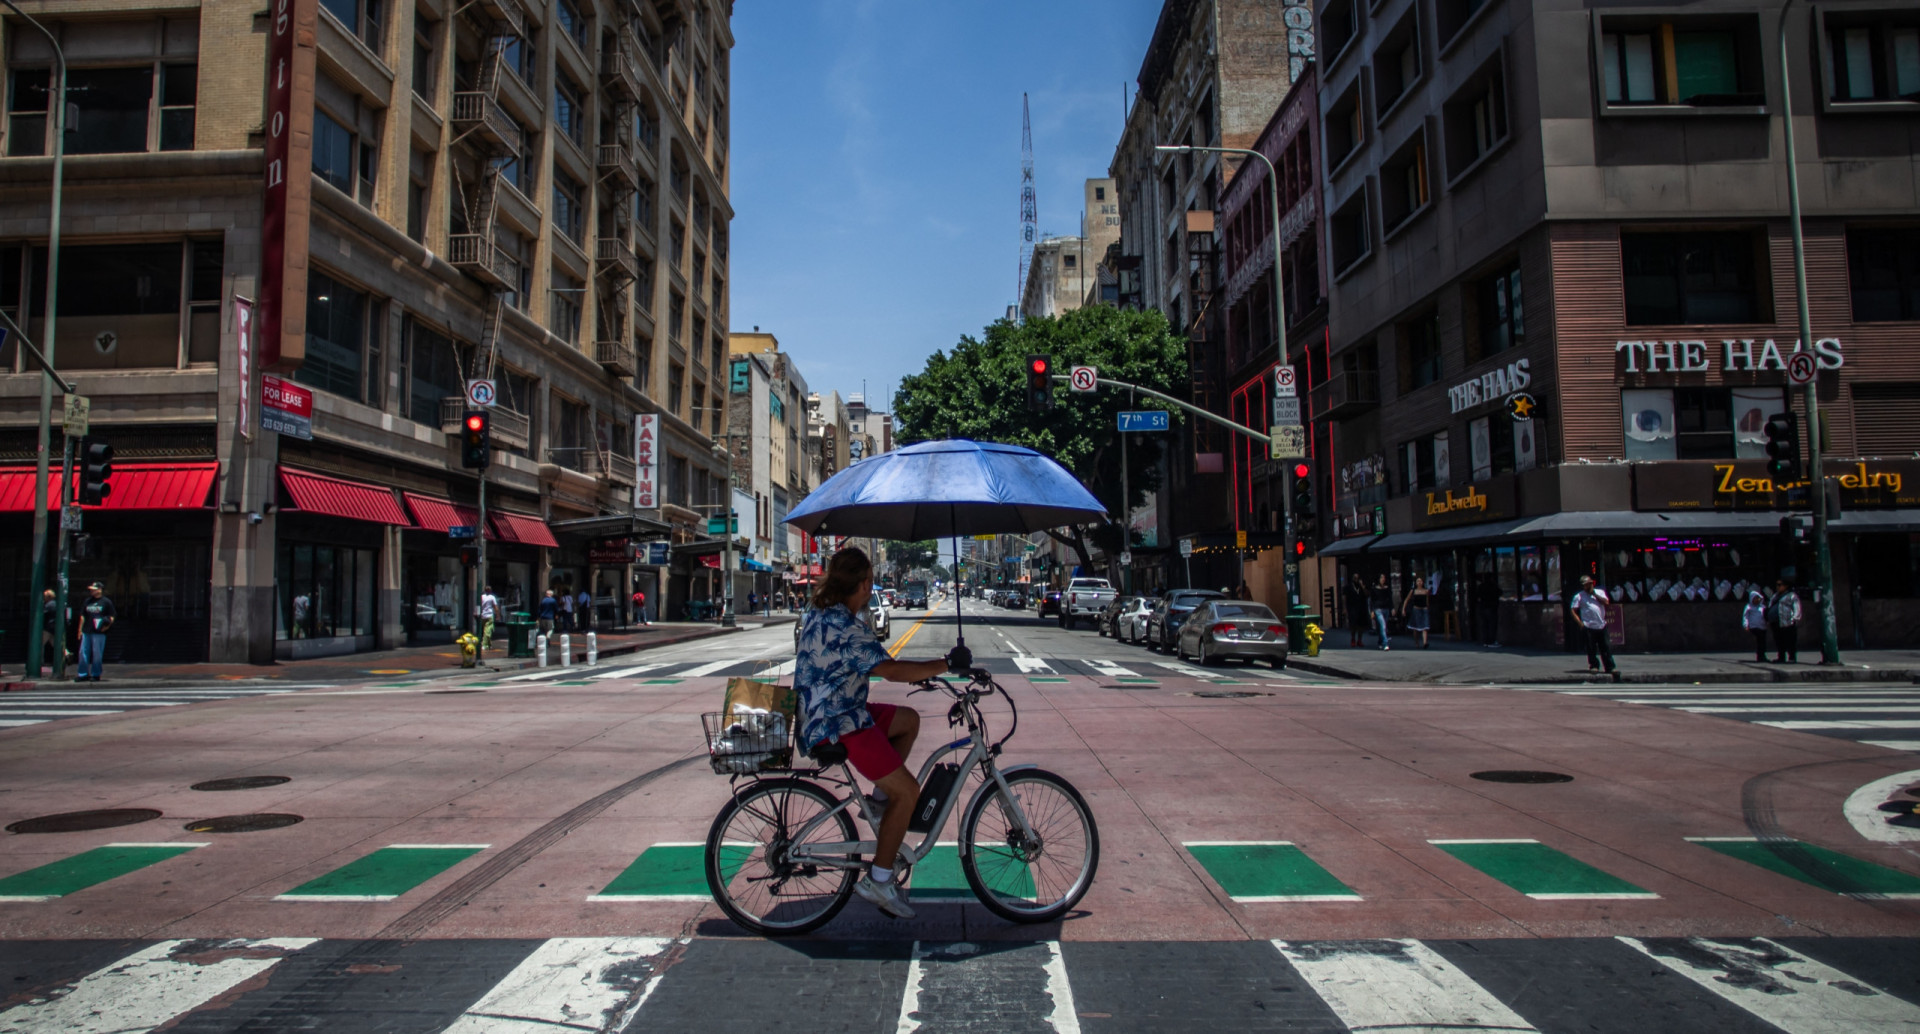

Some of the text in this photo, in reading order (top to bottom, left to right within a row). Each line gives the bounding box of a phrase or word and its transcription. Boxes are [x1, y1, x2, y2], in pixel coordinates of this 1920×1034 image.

[1615, 340, 1709, 373] THE
[264, 386, 280, 401] FOR
[281, 391, 303, 408] LEASE
[1448, 358, 1531, 415] THE HAAS
[1276, 400, 1298, 409] DO NOT
[1276, 410, 1298, 419] BLOCK
[1121, 414, 1165, 429] 7th St
[639, 415, 654, 507] PARKING
